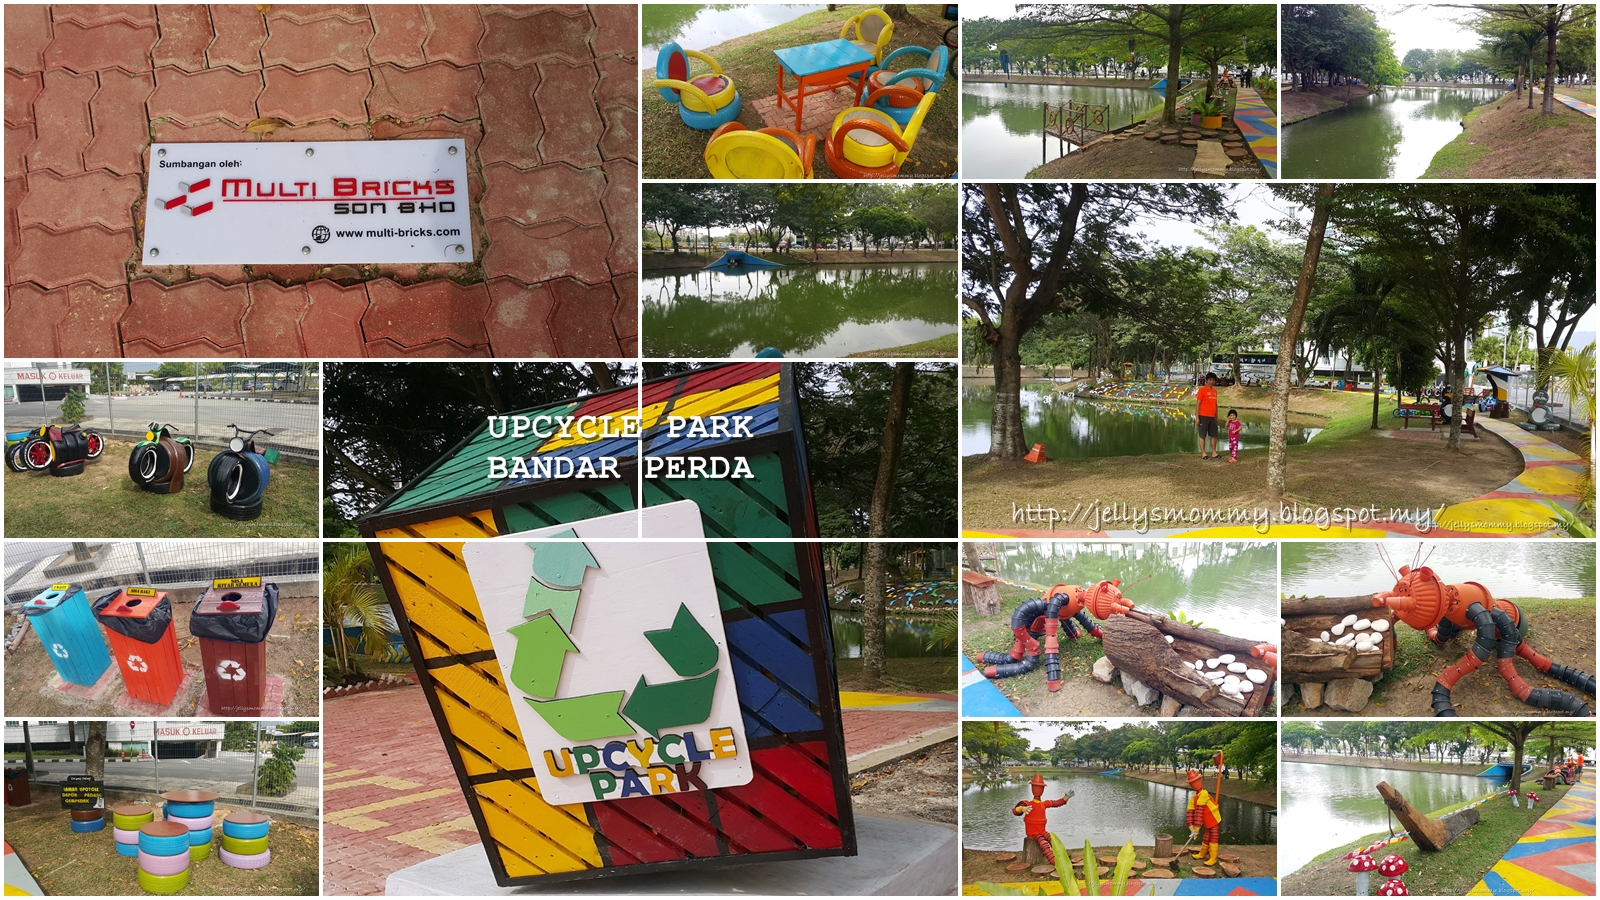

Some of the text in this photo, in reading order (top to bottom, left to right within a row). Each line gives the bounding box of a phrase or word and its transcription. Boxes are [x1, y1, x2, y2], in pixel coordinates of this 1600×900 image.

[159, 159, 242, 170] Sumbangan oleh:
[221, 177, 456, 198] MULTI BRICKS
[397, 201, 456, 214] BHD
[192, 727, 217, 735] KELUAR
[543, 727, 737, 778] UPCYCLE
[588, 761, 708, 801] PARK
